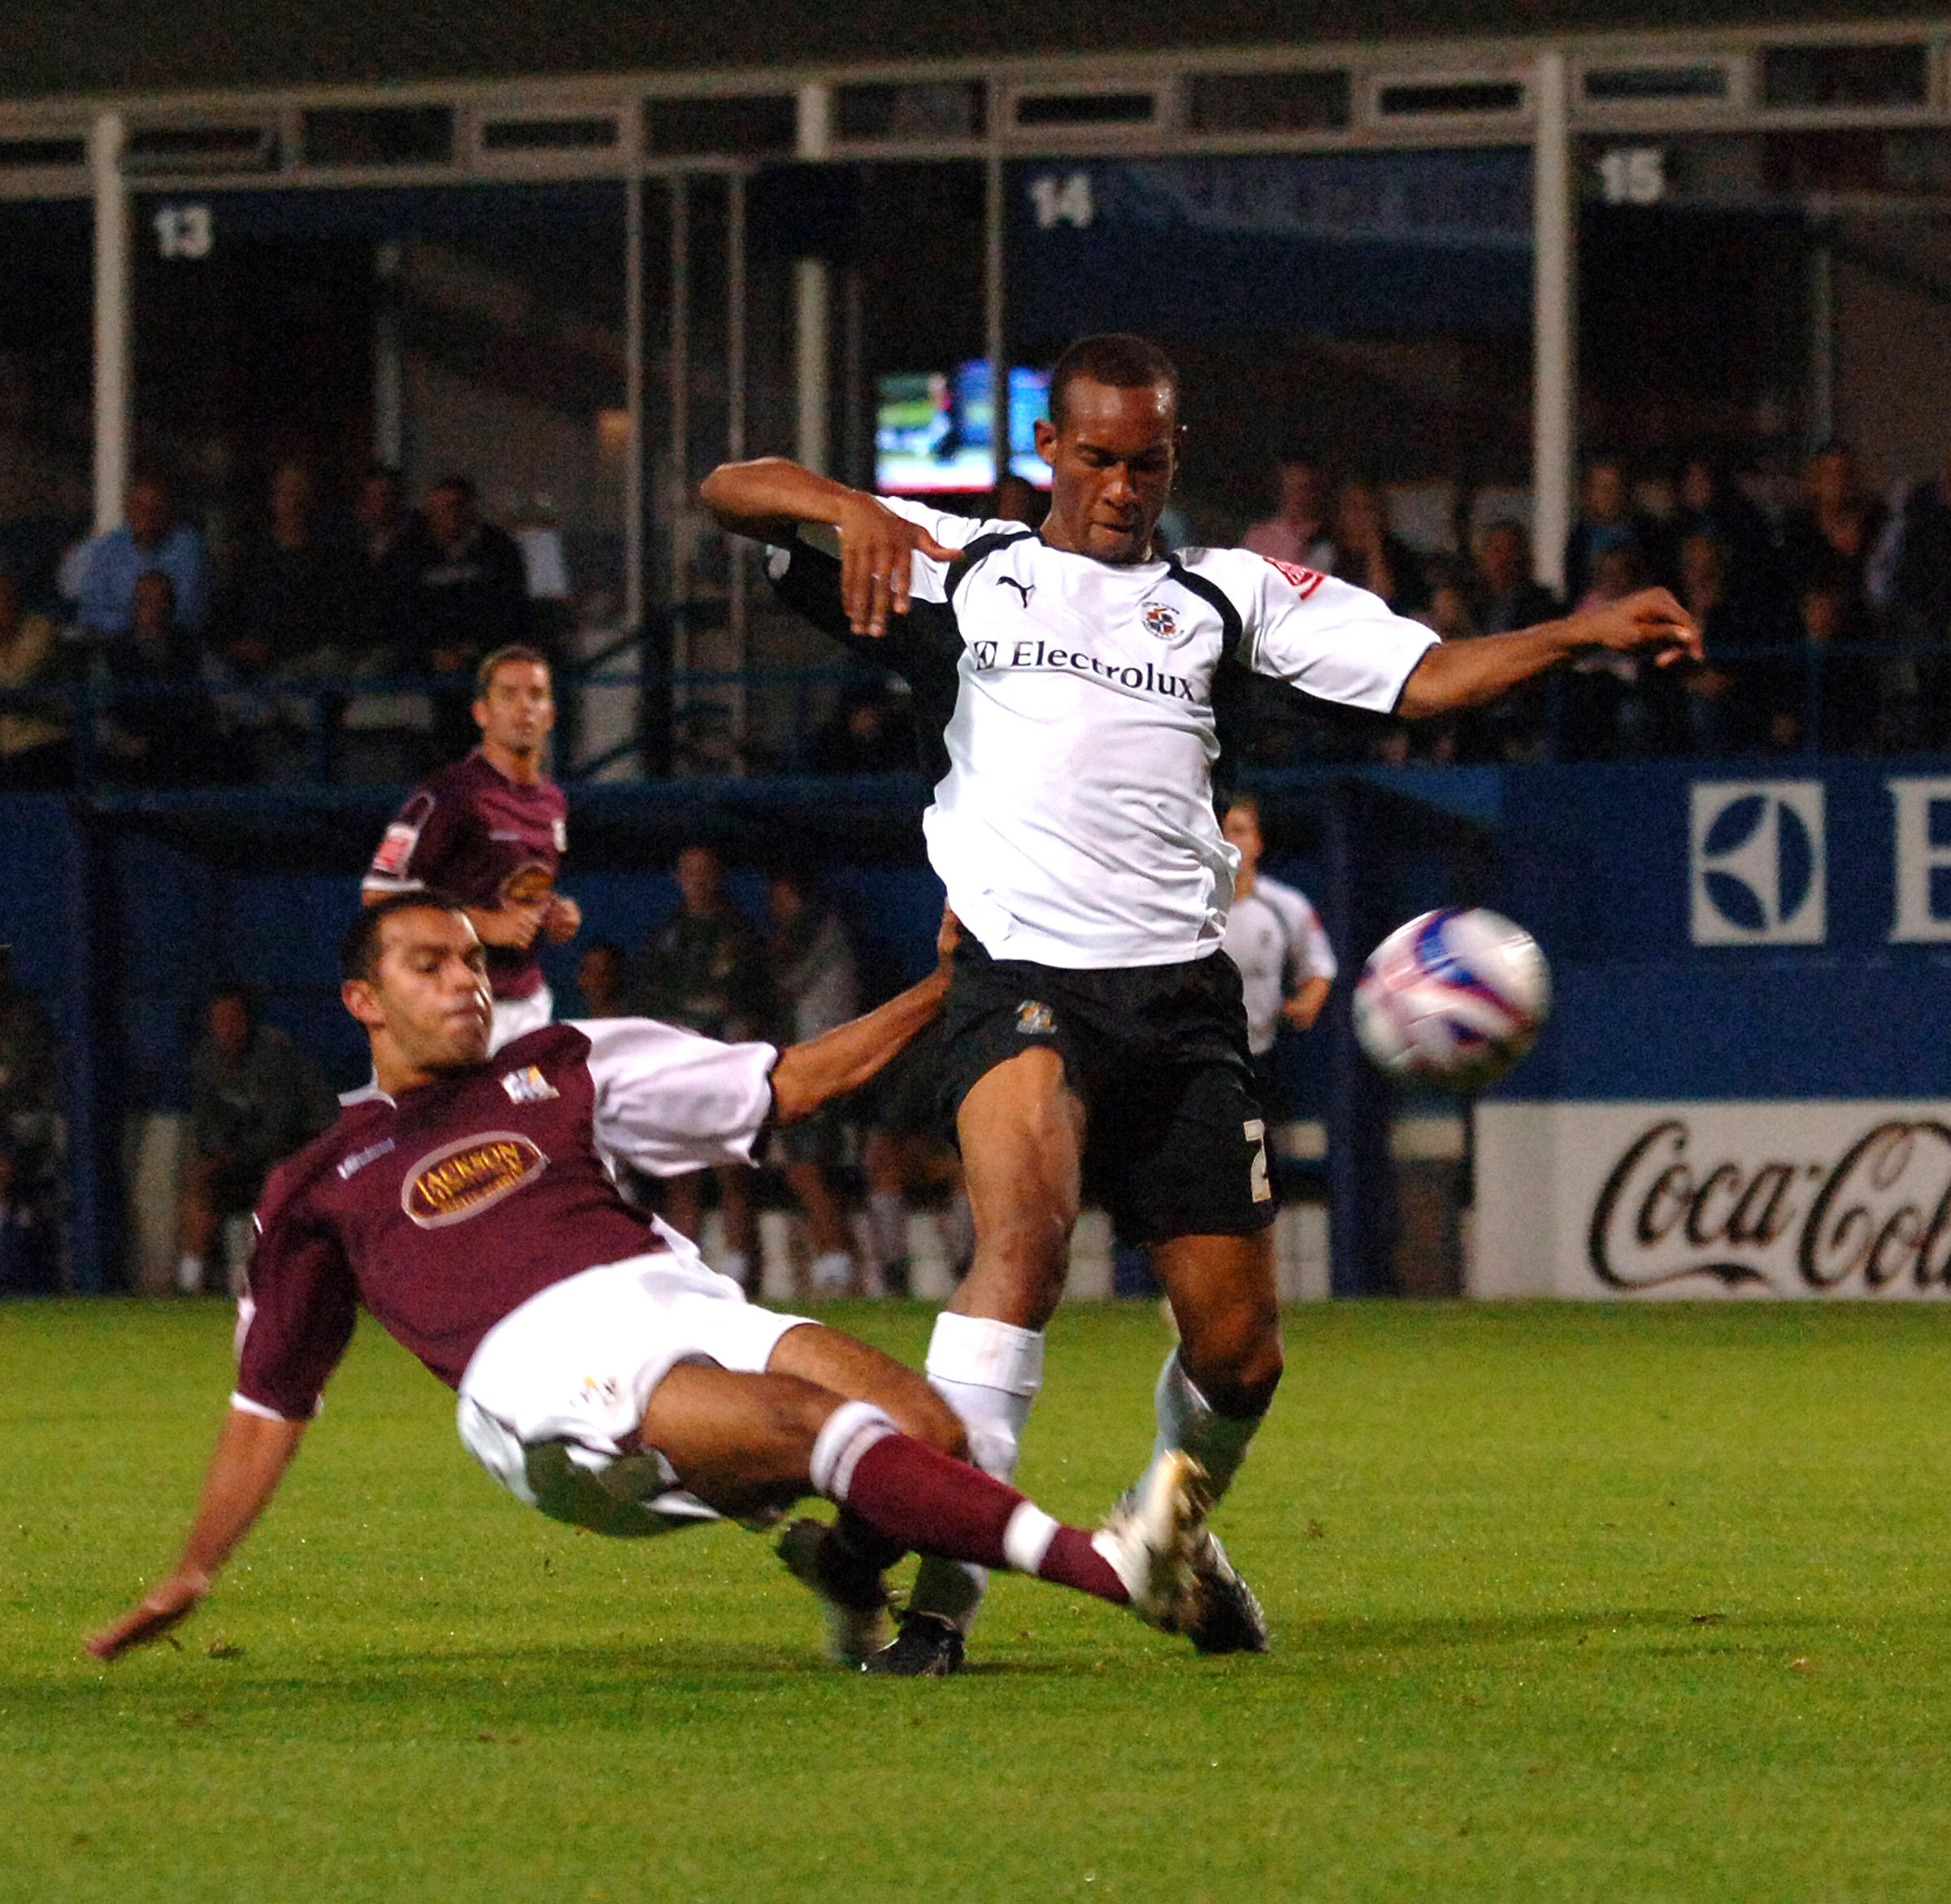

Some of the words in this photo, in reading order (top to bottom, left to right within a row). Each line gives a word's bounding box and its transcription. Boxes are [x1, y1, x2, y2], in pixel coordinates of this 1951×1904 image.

[1031, 173, 1092, 228] 14
[1600, 150, 1664, 204] 15
[155, 206, 211, 259] 13
[1010, 639, 1196, 703] Electrolux
